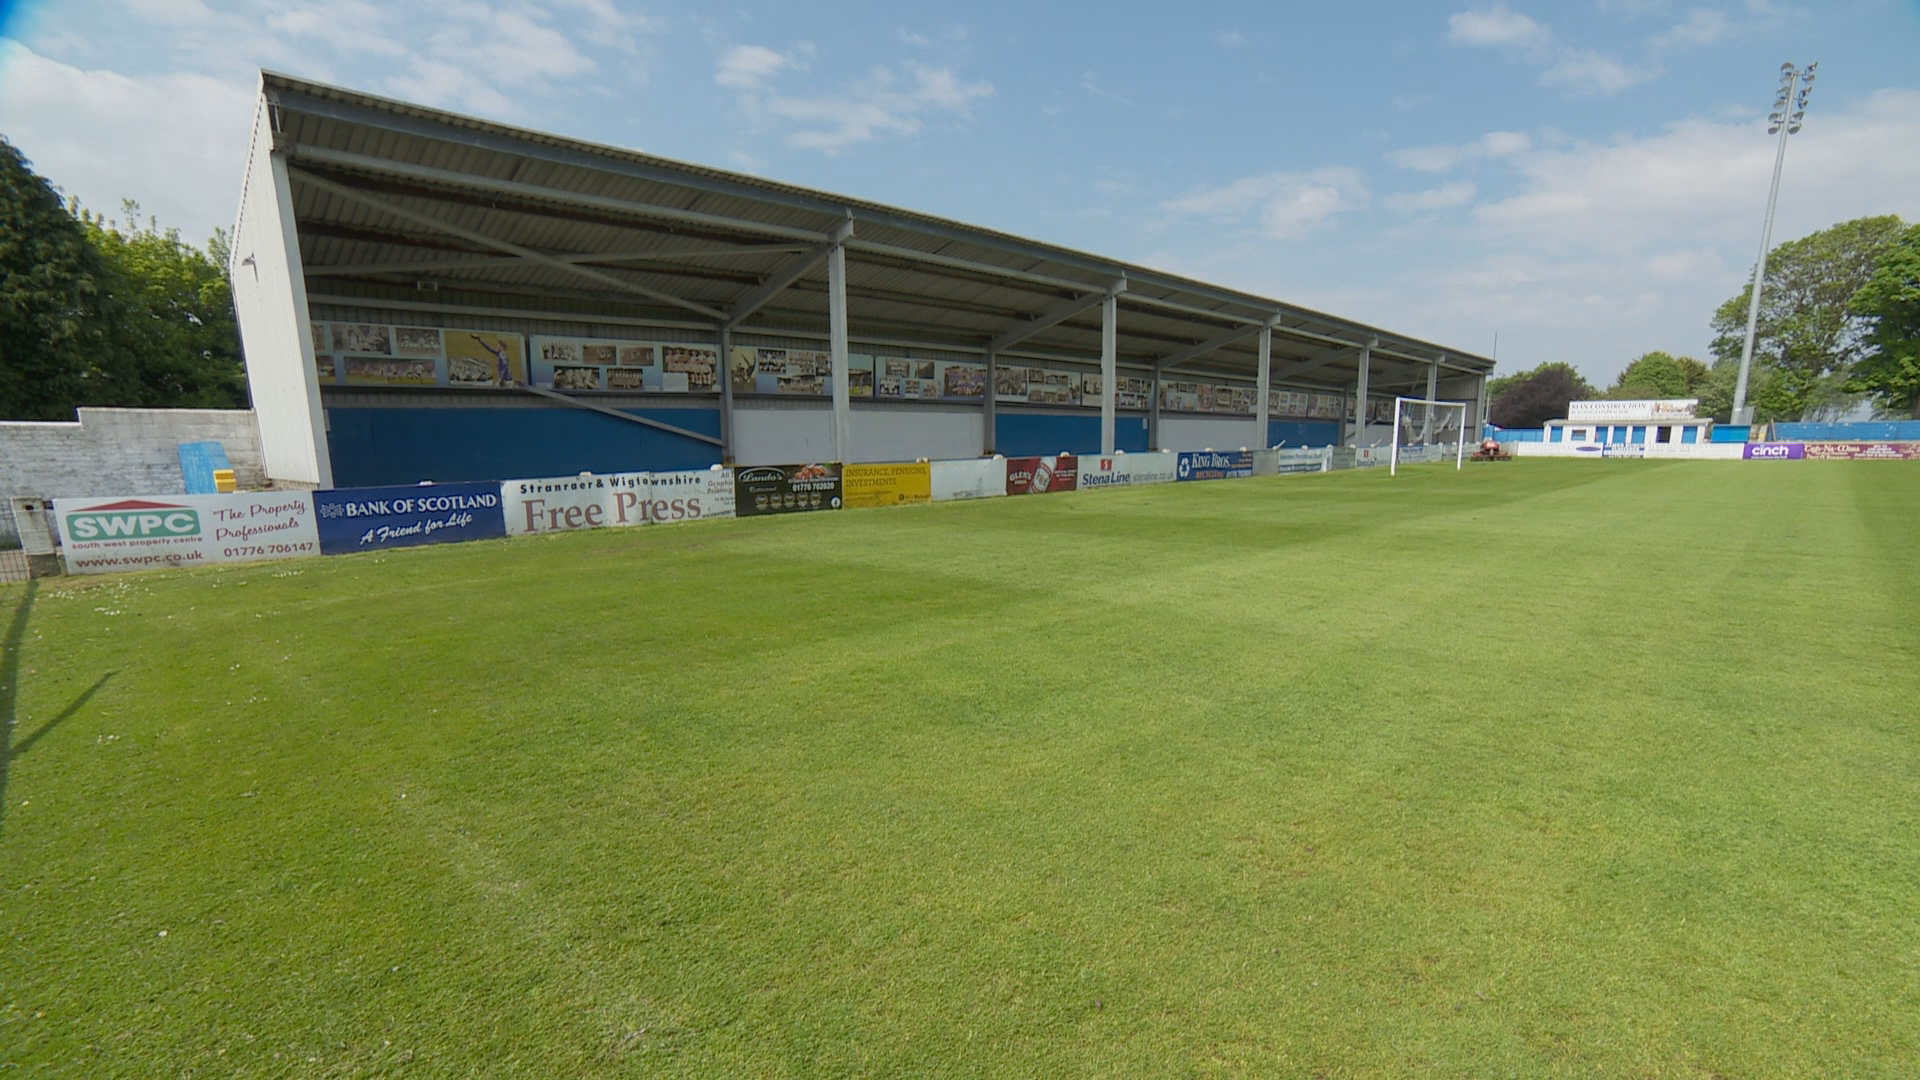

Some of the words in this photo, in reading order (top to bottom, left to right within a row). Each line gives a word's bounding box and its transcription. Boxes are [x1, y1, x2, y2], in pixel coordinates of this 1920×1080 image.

[1752, 444, 1788, 456] cinch
[520, 481, 593, 494] Stranraer
[596, 479, 604, 488] &
[610, 474, 701, 489] Wigtownshire
[792, 483, 811, 492] 01776
[846, 477, 897, 487] INVESTMENTS
[213, 508, 245, 521] The
[250, 500, 307, 518] Property
[346, 501, 391, 517] BANK
[393, 499, 415, 513] OF
[418, 494, 497, 511] SCOTLAND
[521, 499, 603, 533] Free
[613, 492, 702, 523] Press
[74, 513, 195, 538] SWPC
[216, 517, 299, 541] Professionals
[360, 529, 374, 545] A
[376, 521, 422, 542] Friend
[425, 518, 445, 535] for
[445, 512, 473, 528] Life
[72, 541, 100, 549] south
[130, 538, 170, 548] property
[224, 546, 265, 557] 01776
[268, 542, 313, 554] 706147
[76, 550, 203, 568] www.swpc.co.uk
